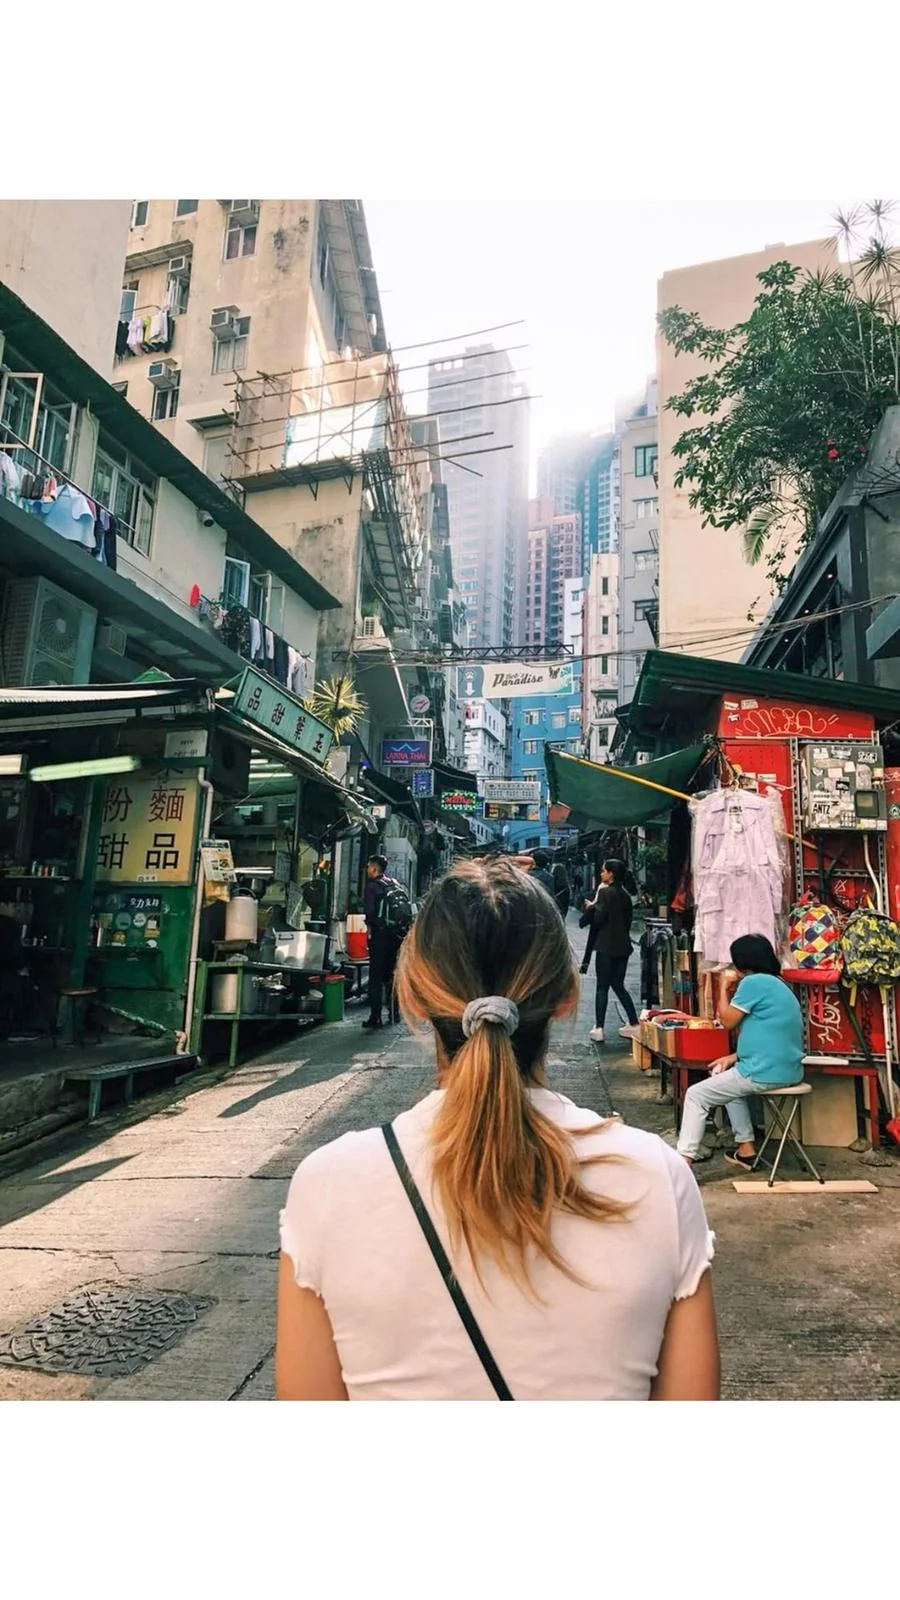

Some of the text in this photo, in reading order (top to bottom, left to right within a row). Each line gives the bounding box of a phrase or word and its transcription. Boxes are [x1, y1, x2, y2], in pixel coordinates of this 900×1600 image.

[493, 672, 544, 688] Paradise
[813, 803, 831, 815] ANTZ
[96, 832, 180, 869] 甜品
